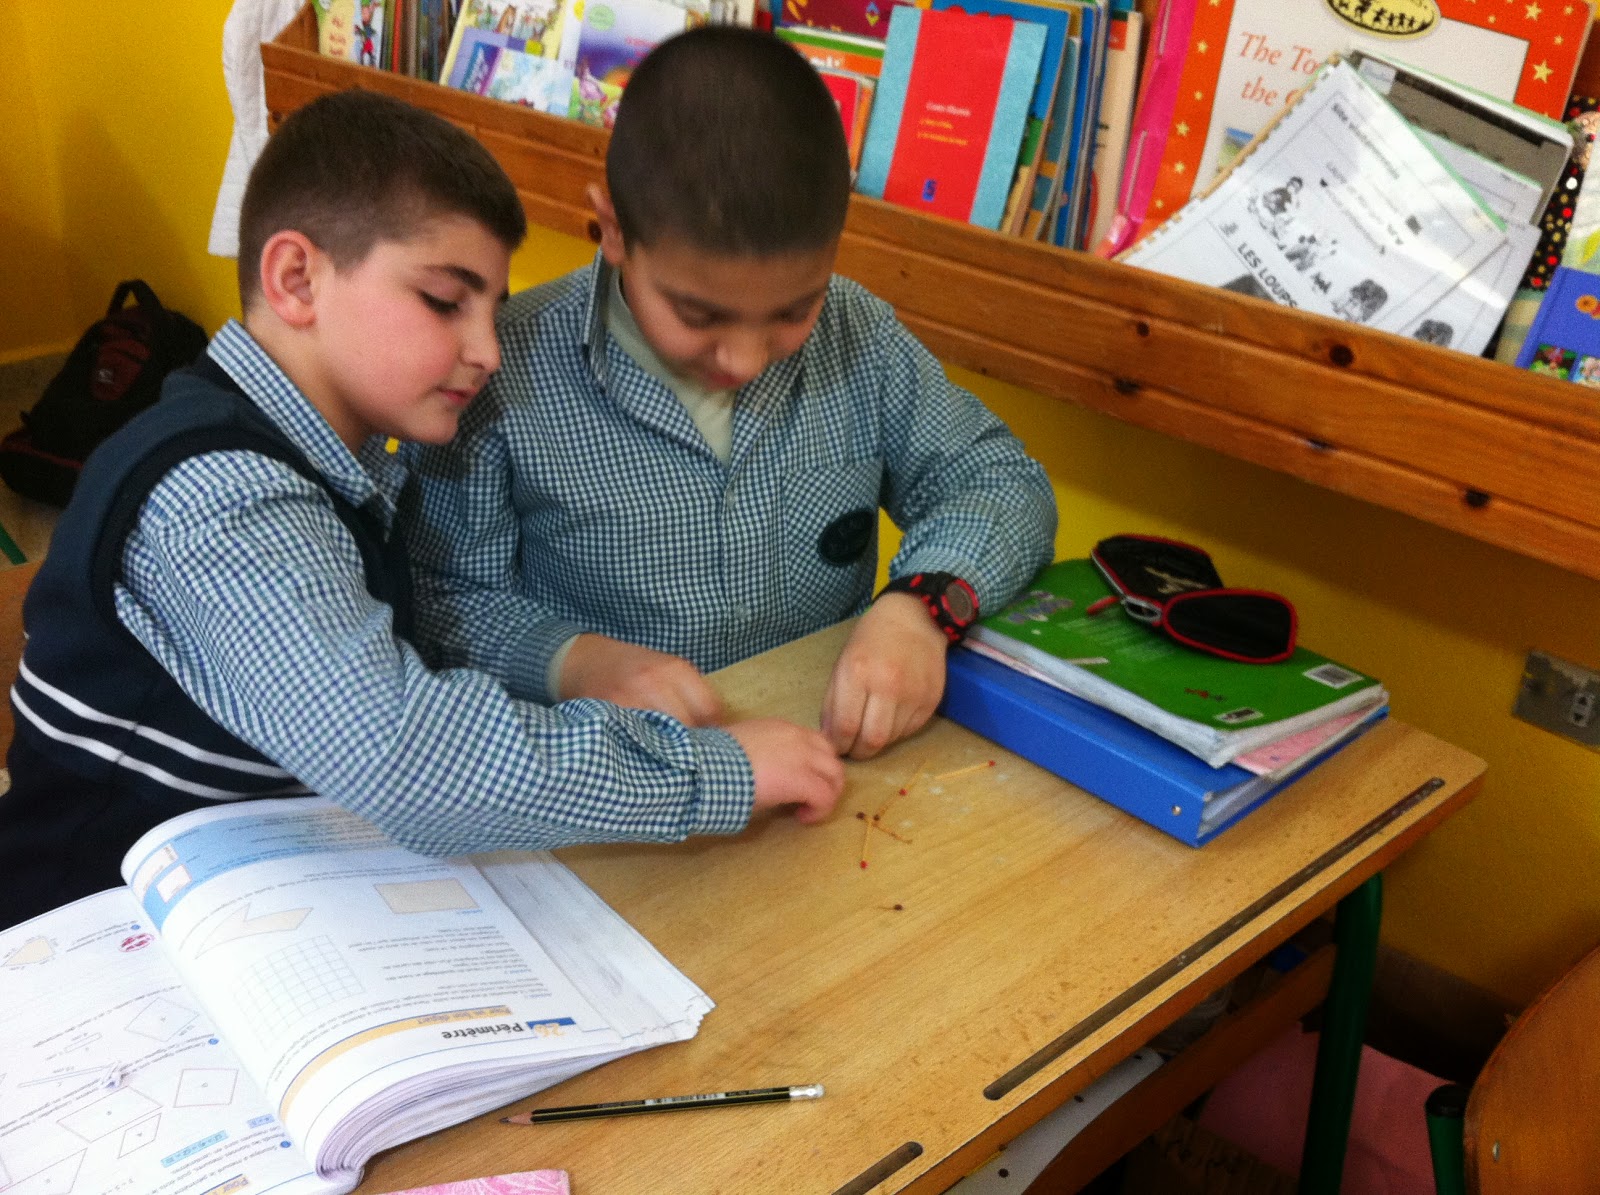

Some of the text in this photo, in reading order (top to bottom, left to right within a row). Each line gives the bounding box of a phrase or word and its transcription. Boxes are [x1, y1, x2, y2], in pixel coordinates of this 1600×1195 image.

[1240, 31, 1323, 75] The To
[1241, 75, 1278, 107] the
[1237, 242, 1262, 268] LES
[441, 1022, 524, 1040] Périmètre
